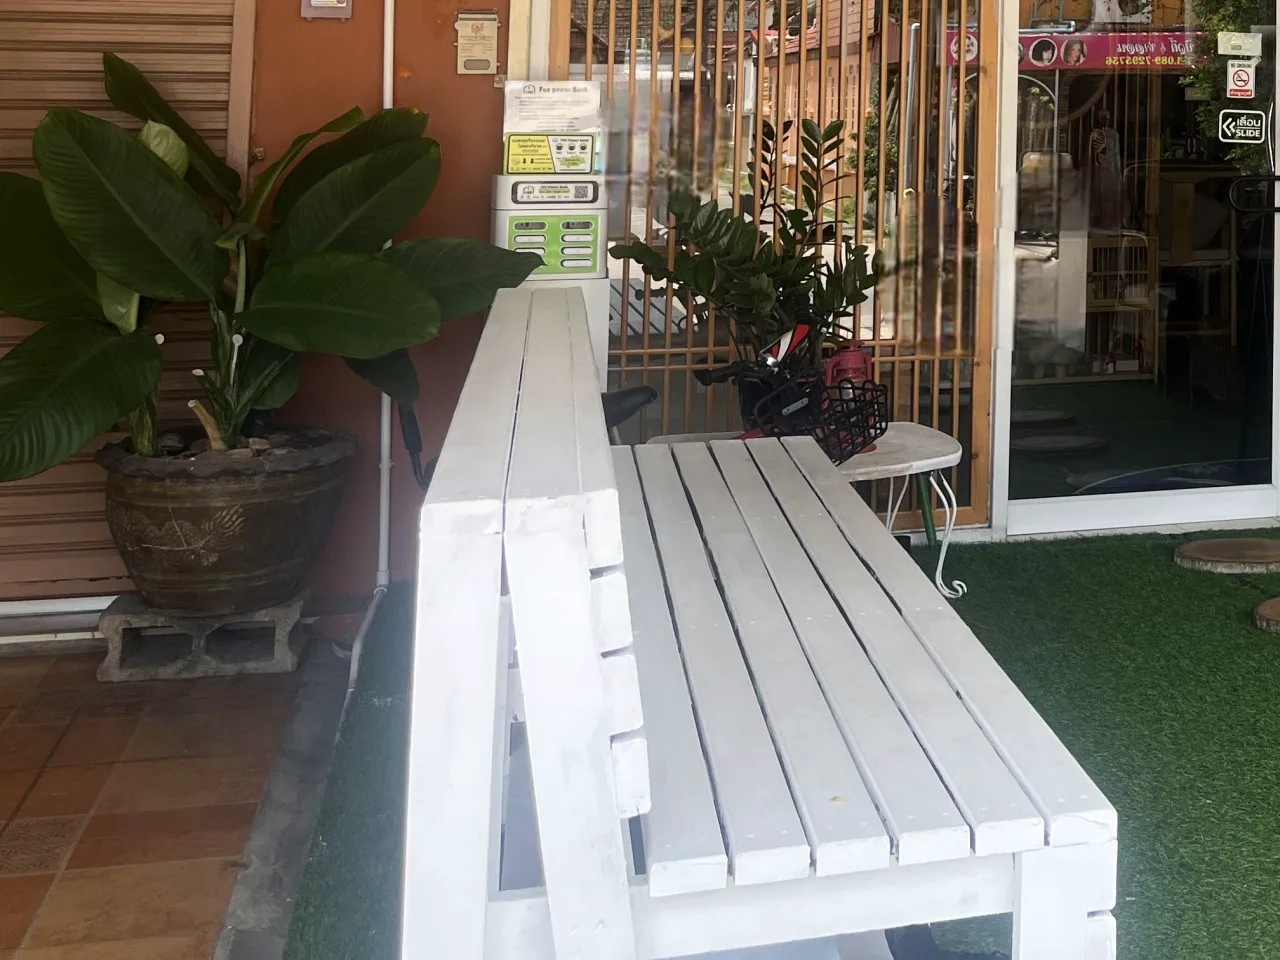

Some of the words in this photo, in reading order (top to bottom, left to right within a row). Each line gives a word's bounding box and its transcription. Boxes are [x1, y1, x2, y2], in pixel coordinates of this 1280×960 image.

[1236, 114, 1261, 127] เลื่อน
[1236, 129, 1261, 137] SLIDE
